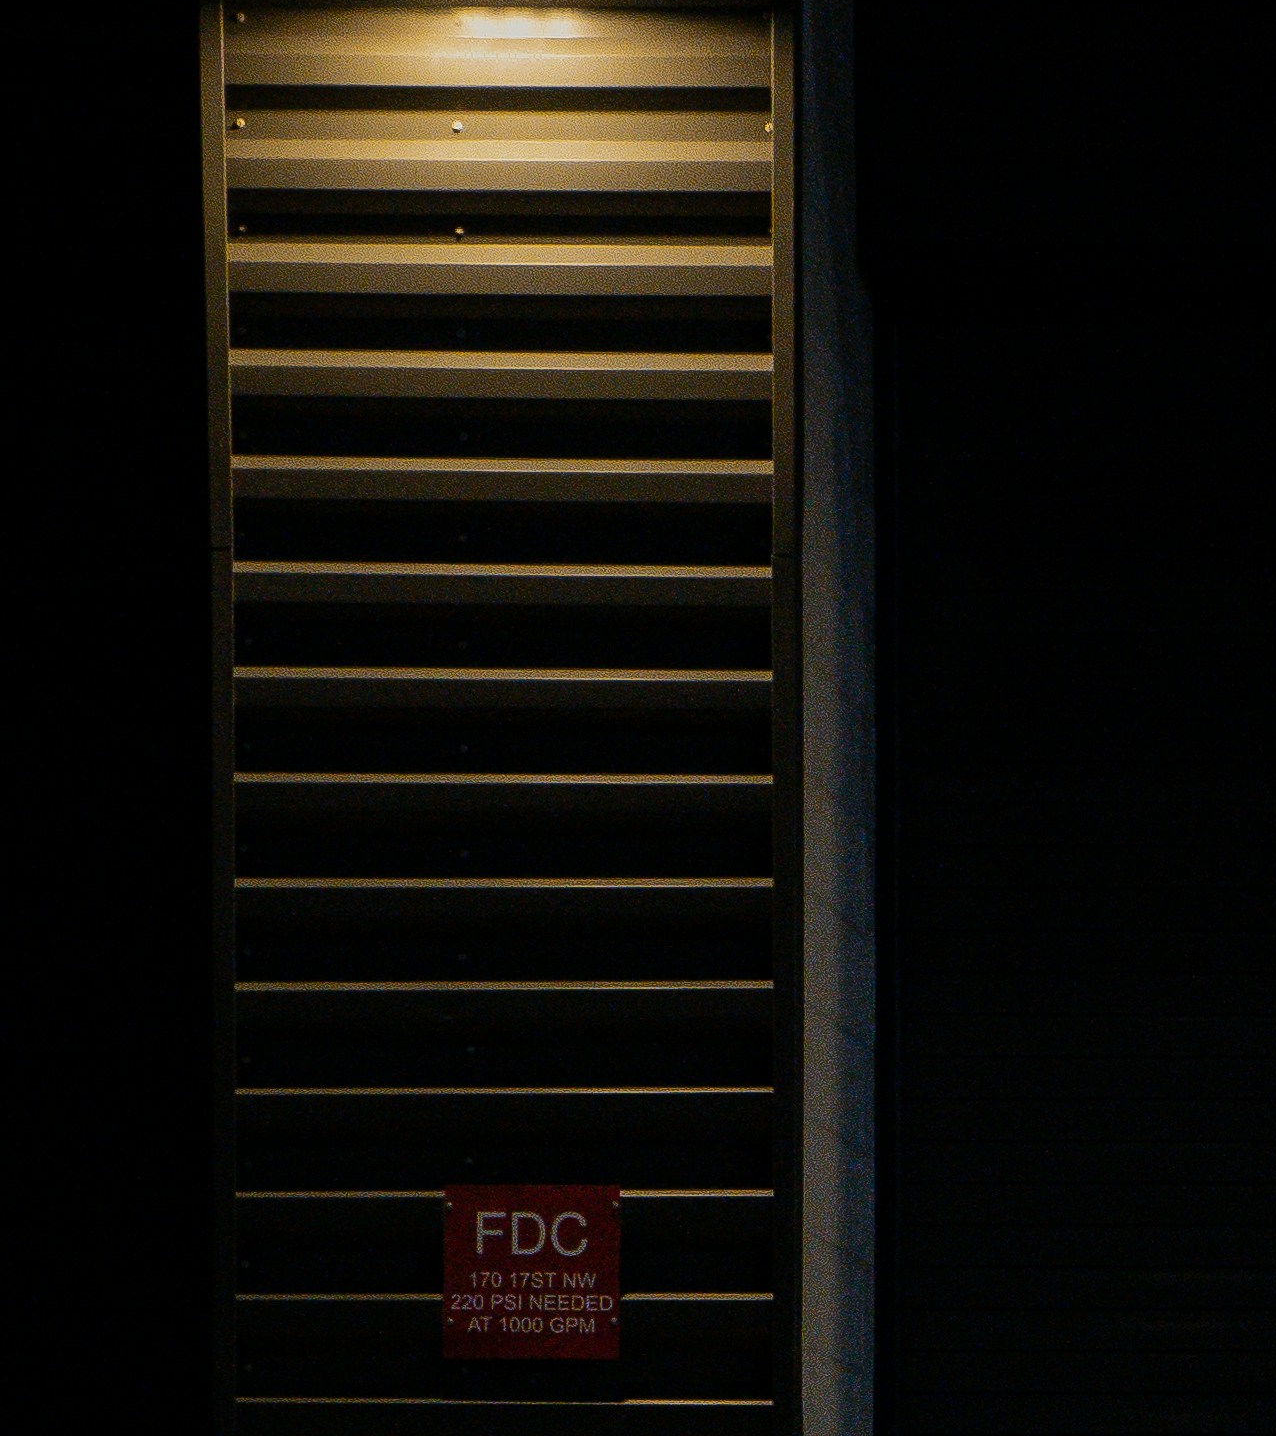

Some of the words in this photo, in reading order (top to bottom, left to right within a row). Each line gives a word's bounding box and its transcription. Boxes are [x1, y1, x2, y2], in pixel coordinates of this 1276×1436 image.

[476, 1210, 589, 1256] FDC
[469, 1271, 502, 1288] 170
[510, 1271, 556, 1288] 17ST
[562, 1272, 597, 1288] NW
[450, 1293, 484, 1310] 220
[490, 1293, 522, 1311] PSI
[528, 1294, 613, 1311] NEEDED
[467, 1316, 493, 1332] AT
[500, 1316, 544, 1333] 1000
[549, 1316, 596, 1333] GPM
